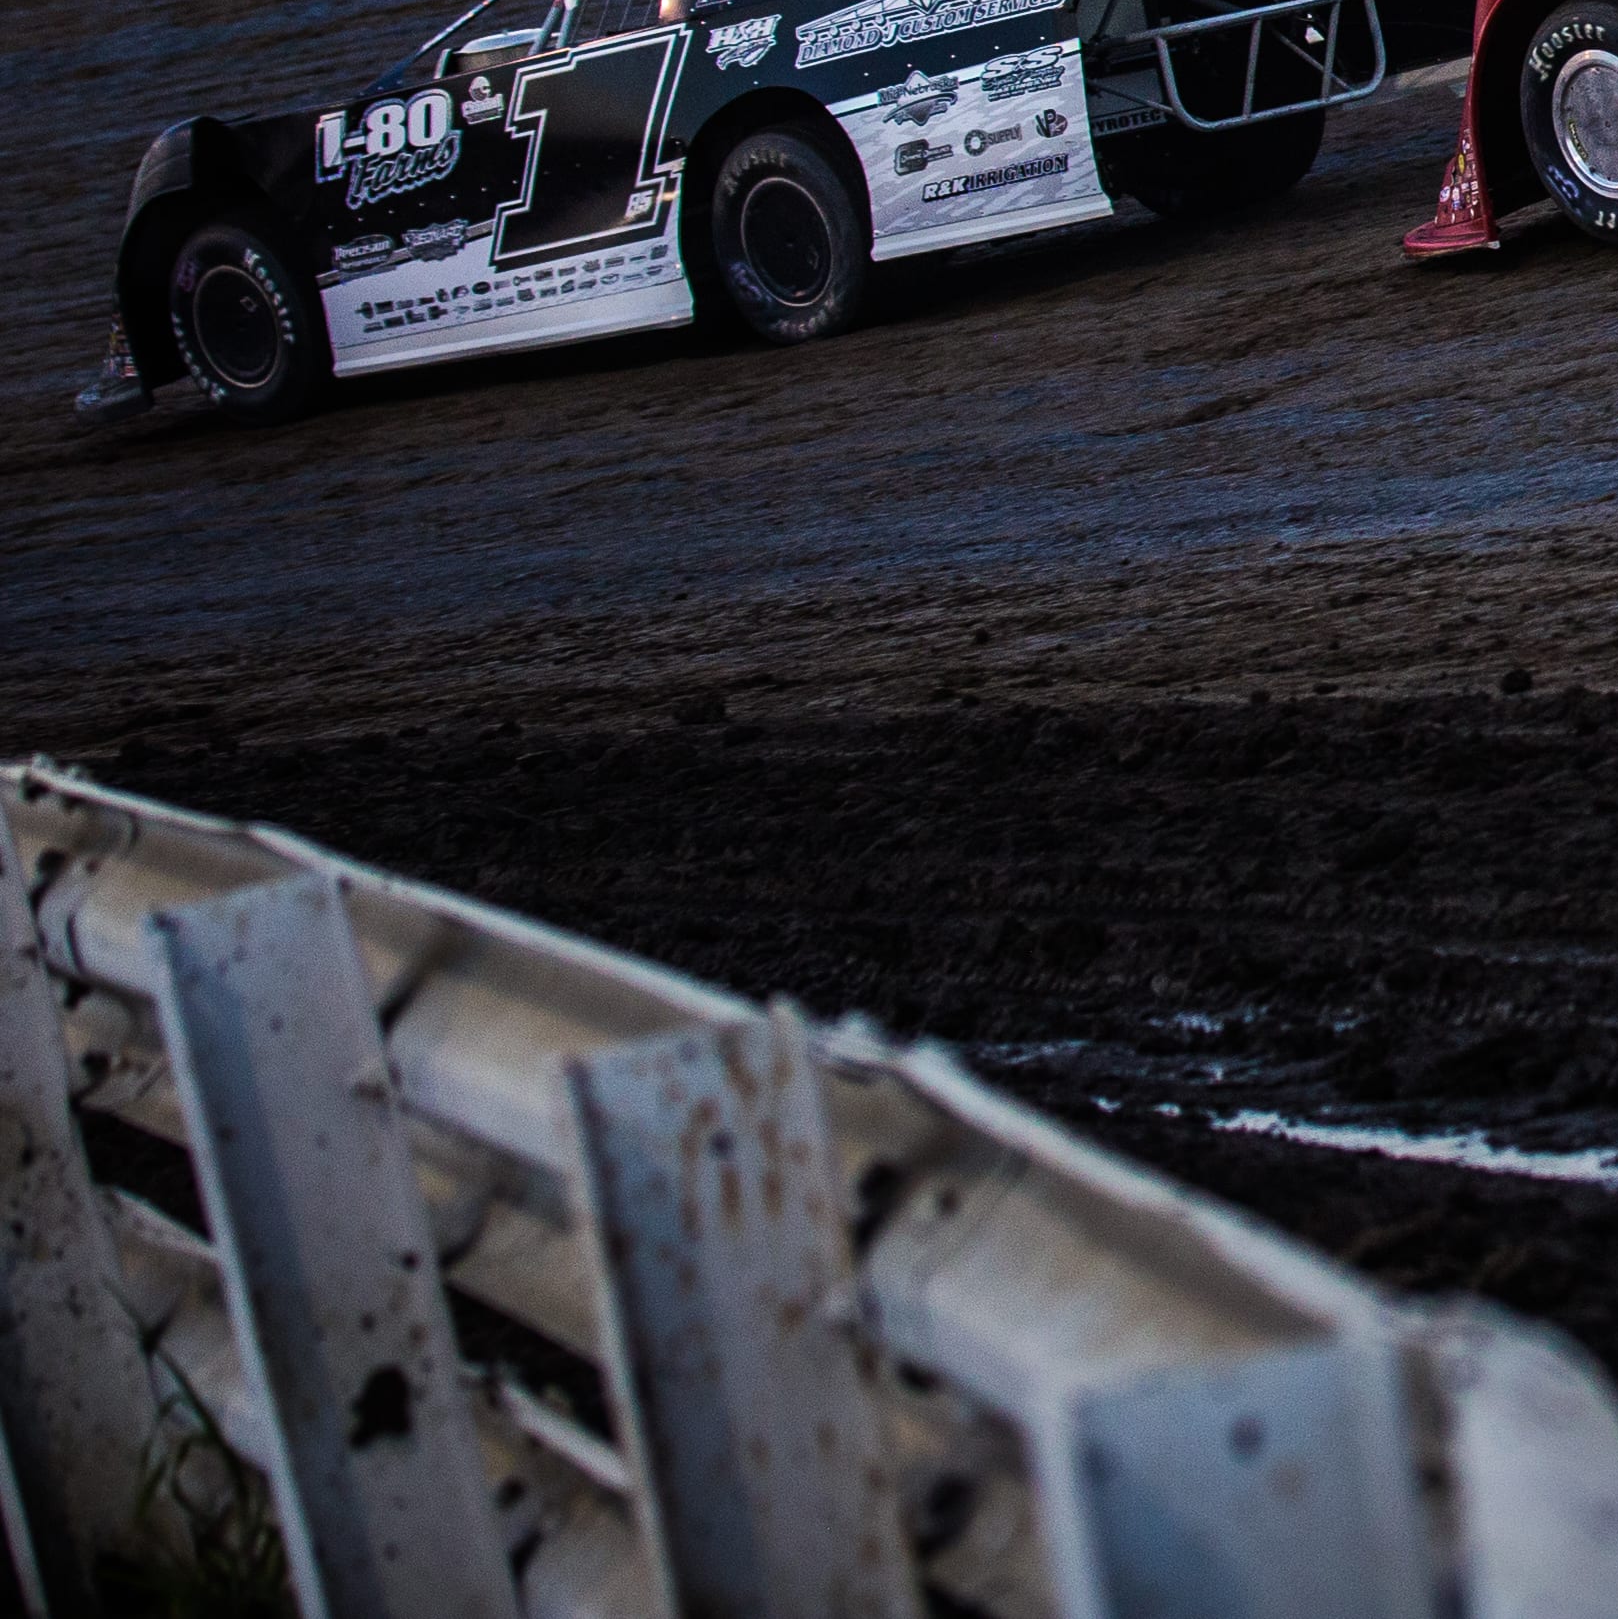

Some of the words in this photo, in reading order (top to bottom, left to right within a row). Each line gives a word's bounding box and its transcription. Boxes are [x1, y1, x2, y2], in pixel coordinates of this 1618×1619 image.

[801, 30, 881, 62] DIAMOND
[900, 7, 971, 39] CUSTOM
[318, 90, 451, 169] I-80
[493, 27, 691, 266] 1
[349, 133, 453, 198] Farms
[922, 177, 971, 203] R&K
[969, 153, 1069, 192] IRRIGATION
